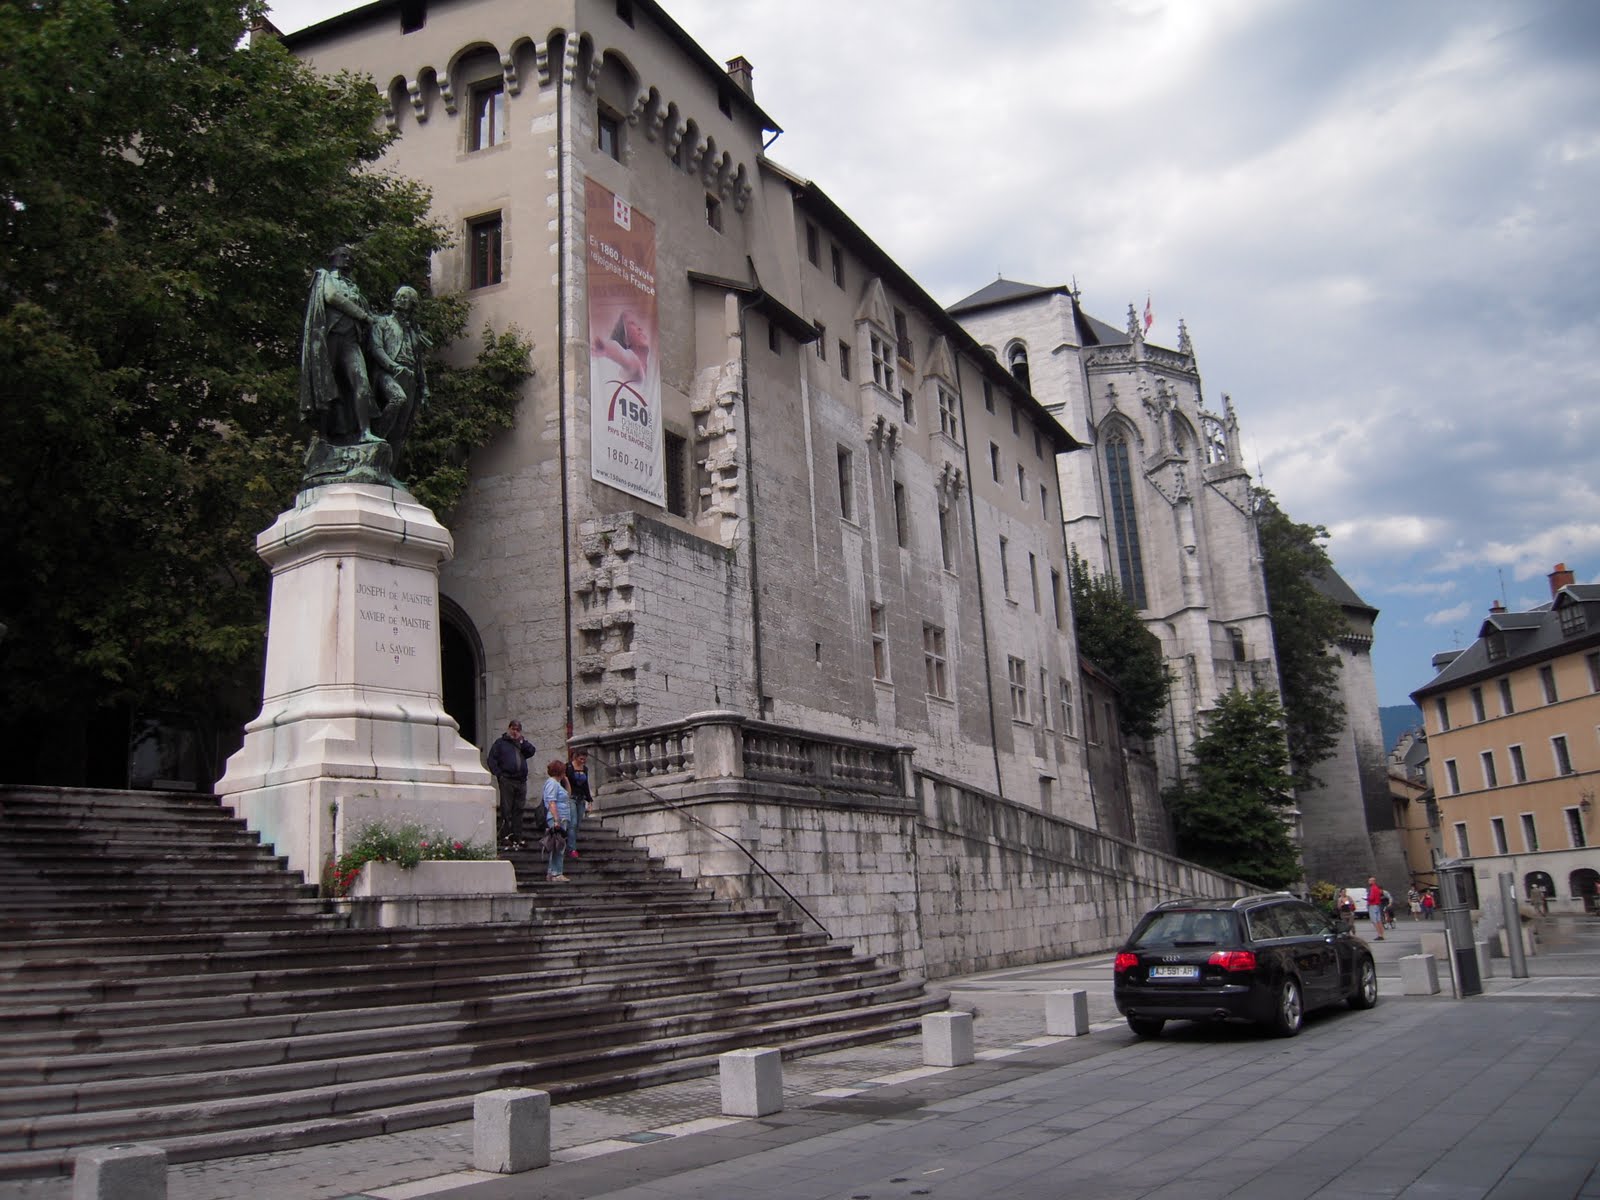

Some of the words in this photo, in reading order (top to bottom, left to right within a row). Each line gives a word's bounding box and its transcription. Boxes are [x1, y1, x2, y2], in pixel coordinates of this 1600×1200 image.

[621, 255, 628, 267] la
[629, 260, 654, 283] Savoie
[622, 268, 629, 281] la
[630, 274, 656, 296] France
[618, 398, 648, 427] 150
[356, 583, 386, 598] JOSEPH
[389, 591, 398, 601] DE
[401, 591, 433, 607] MAISTRE
[359, 609, 386, 623] XAVIER
[388, 616, 397, 625] DE
[401, 616, 431, 631] MAISTRE
[375, 641, 386, 653] LA
[389, 643, 416, 657] SAVOIE
